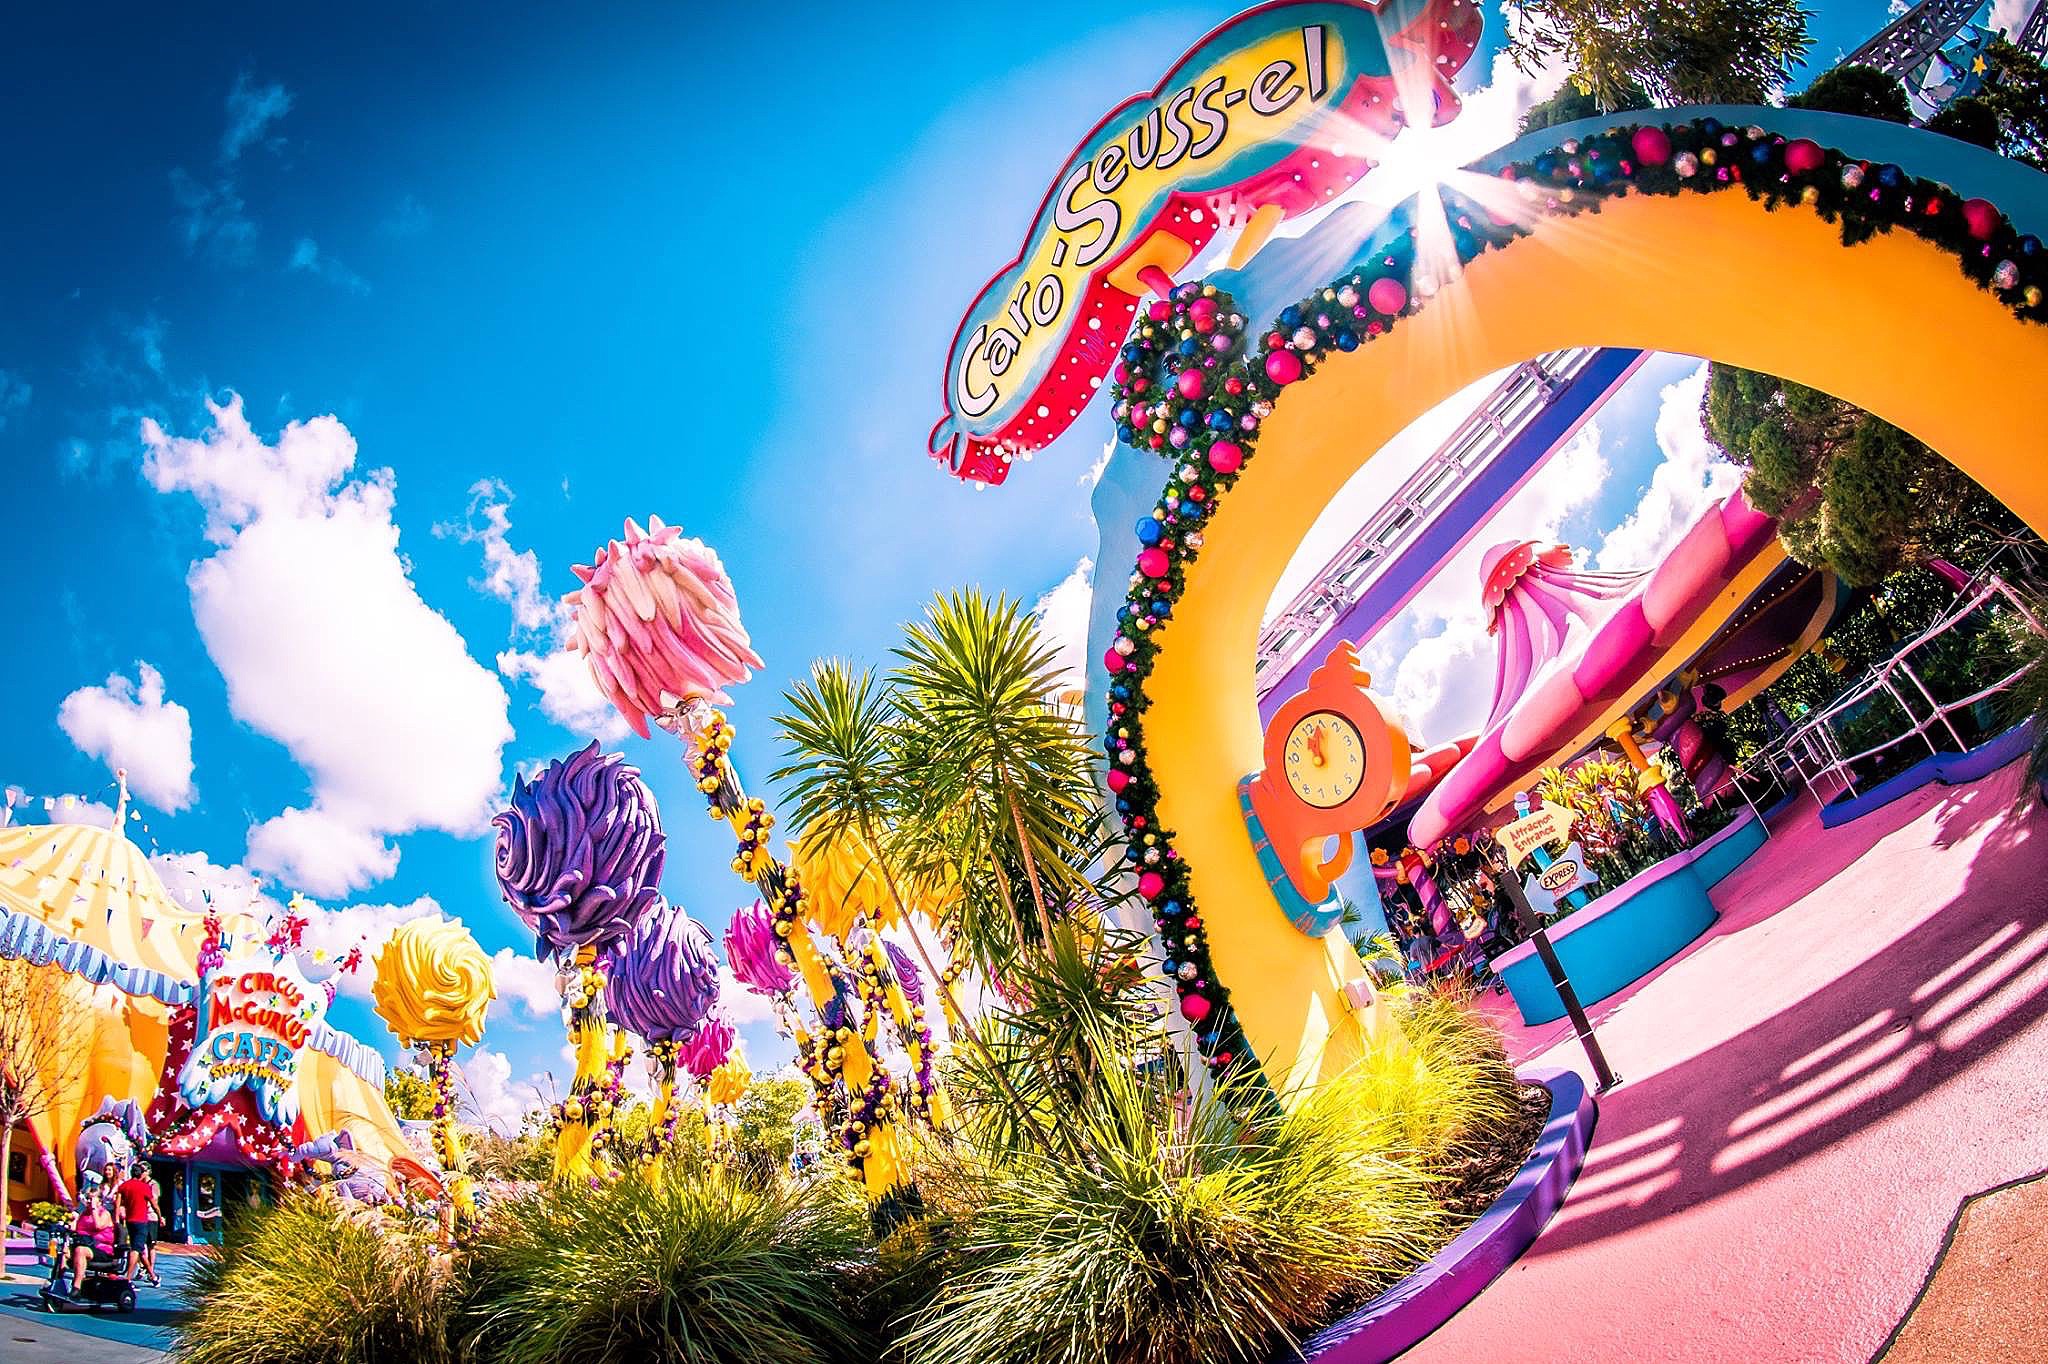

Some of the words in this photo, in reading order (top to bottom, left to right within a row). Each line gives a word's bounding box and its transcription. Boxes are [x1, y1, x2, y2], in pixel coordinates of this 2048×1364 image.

[956, 24, 1328, 418] Caro-Seuss-el
[1302, 723, 1315, 736] 12
[1318, 719, 1327, 728] 1
[1331, 721, 1342, 733] 2
[1292, 737, 1303, 748] 11
[1344, 735, 1353, 746] 3
[1288, 752, 1300, 764] 10
[1350, 754, 1357, 764] 4
[1292, 771, 1300, 782] 9
[1344, 774, 1353, 785] 5
[1302, 784, 1311, 794] 8
[1317, 788, 1326, 799] 7
[1334, 784, 1342, 796] 6
[1508, 814, 1554, 842] Attraction
[1513, 825, 1557, 853] Entrance
[1543, 863, 1575, 888] EXPRESS
[240, 972, 304, 1007] CIRCUS
[212, 1031, 294, 1071] CAFE
